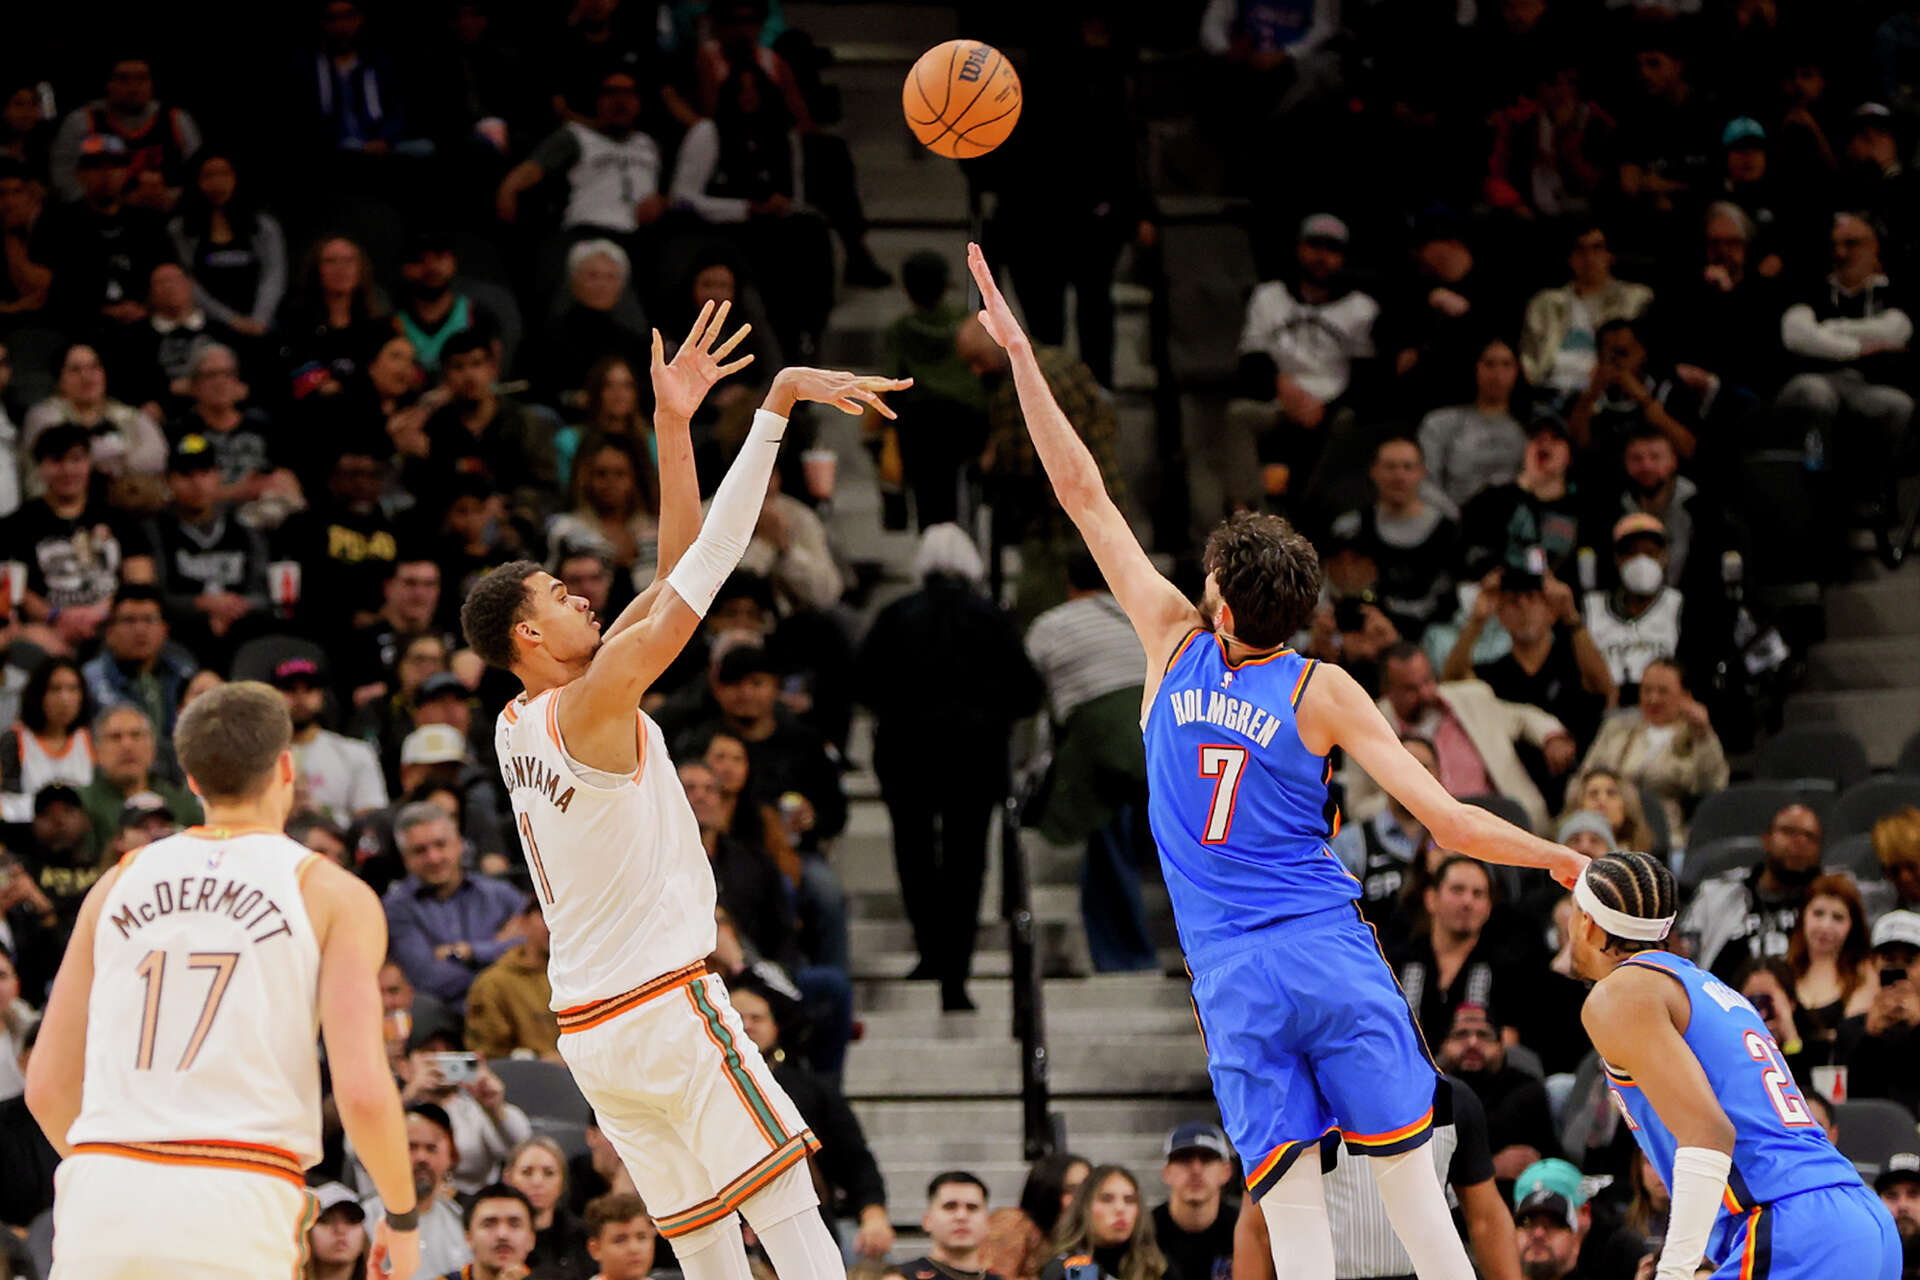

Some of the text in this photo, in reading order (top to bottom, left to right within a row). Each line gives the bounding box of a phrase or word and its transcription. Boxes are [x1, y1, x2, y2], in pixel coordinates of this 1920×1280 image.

[1170, 688, 1281, 749] HOLMGREN
[1198, 743, 1250, 845] 7
[519, 812, 555, 905] 1
[111, 877, 292, 943] McDERMOTT
[136, 950, 241, 1072] 17
